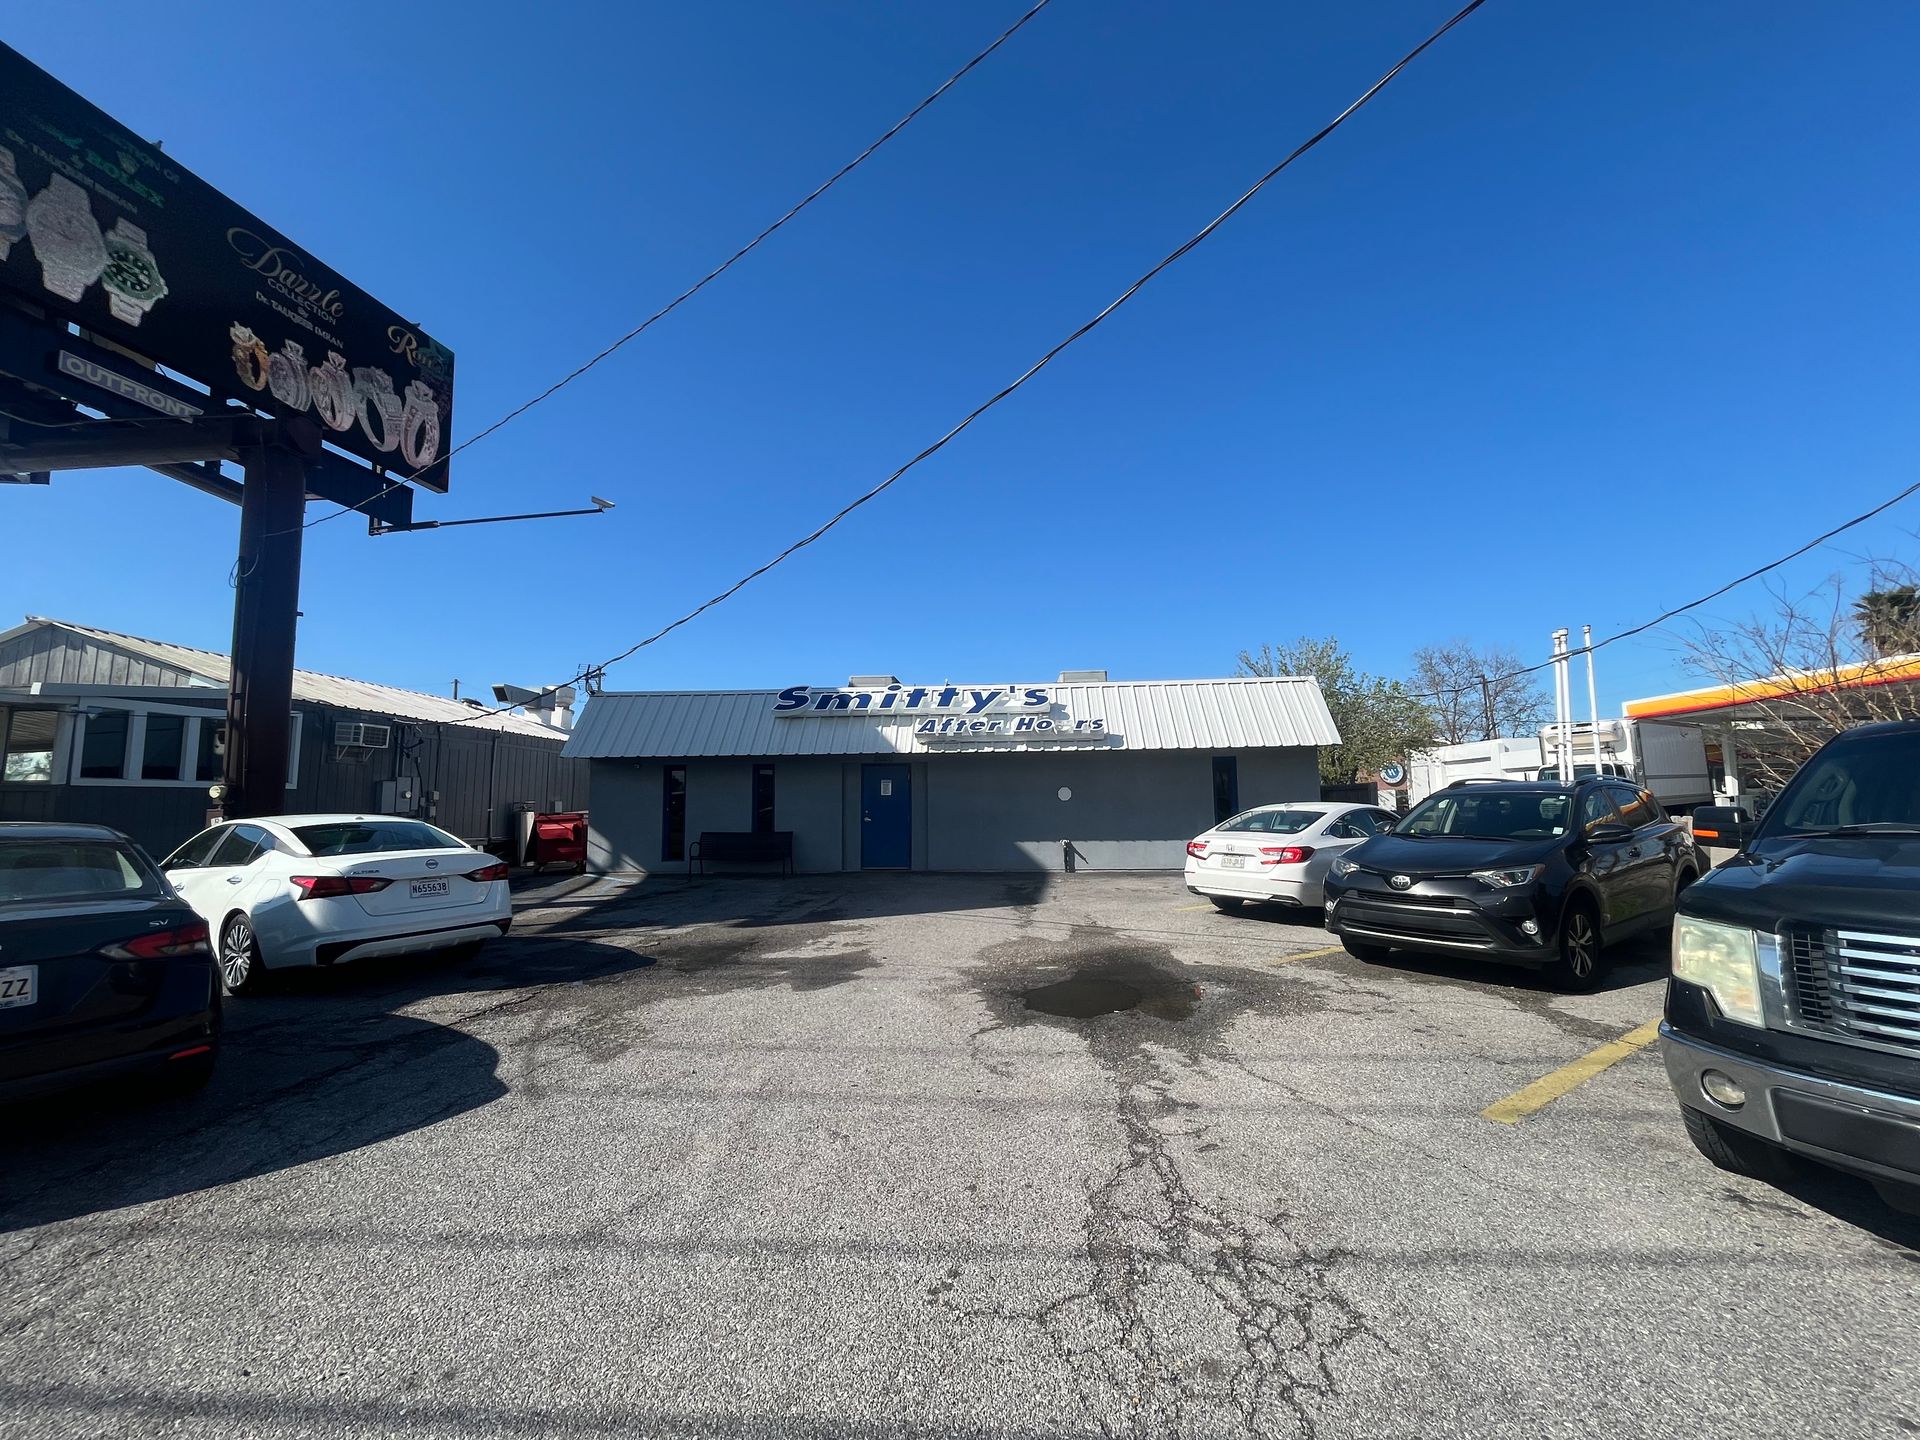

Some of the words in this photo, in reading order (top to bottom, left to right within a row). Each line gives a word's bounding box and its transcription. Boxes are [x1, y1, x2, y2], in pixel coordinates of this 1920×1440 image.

[267, 278, 337, 325] COLLECTION
[66, 357, 197, 417] OUTFRONT
[773, 684, 1050, 715] Smitty's
[917, 717, 1004, 734] After
[1014, 715, 1106, 732] Hors
[149, 918, 169, 928] SV
